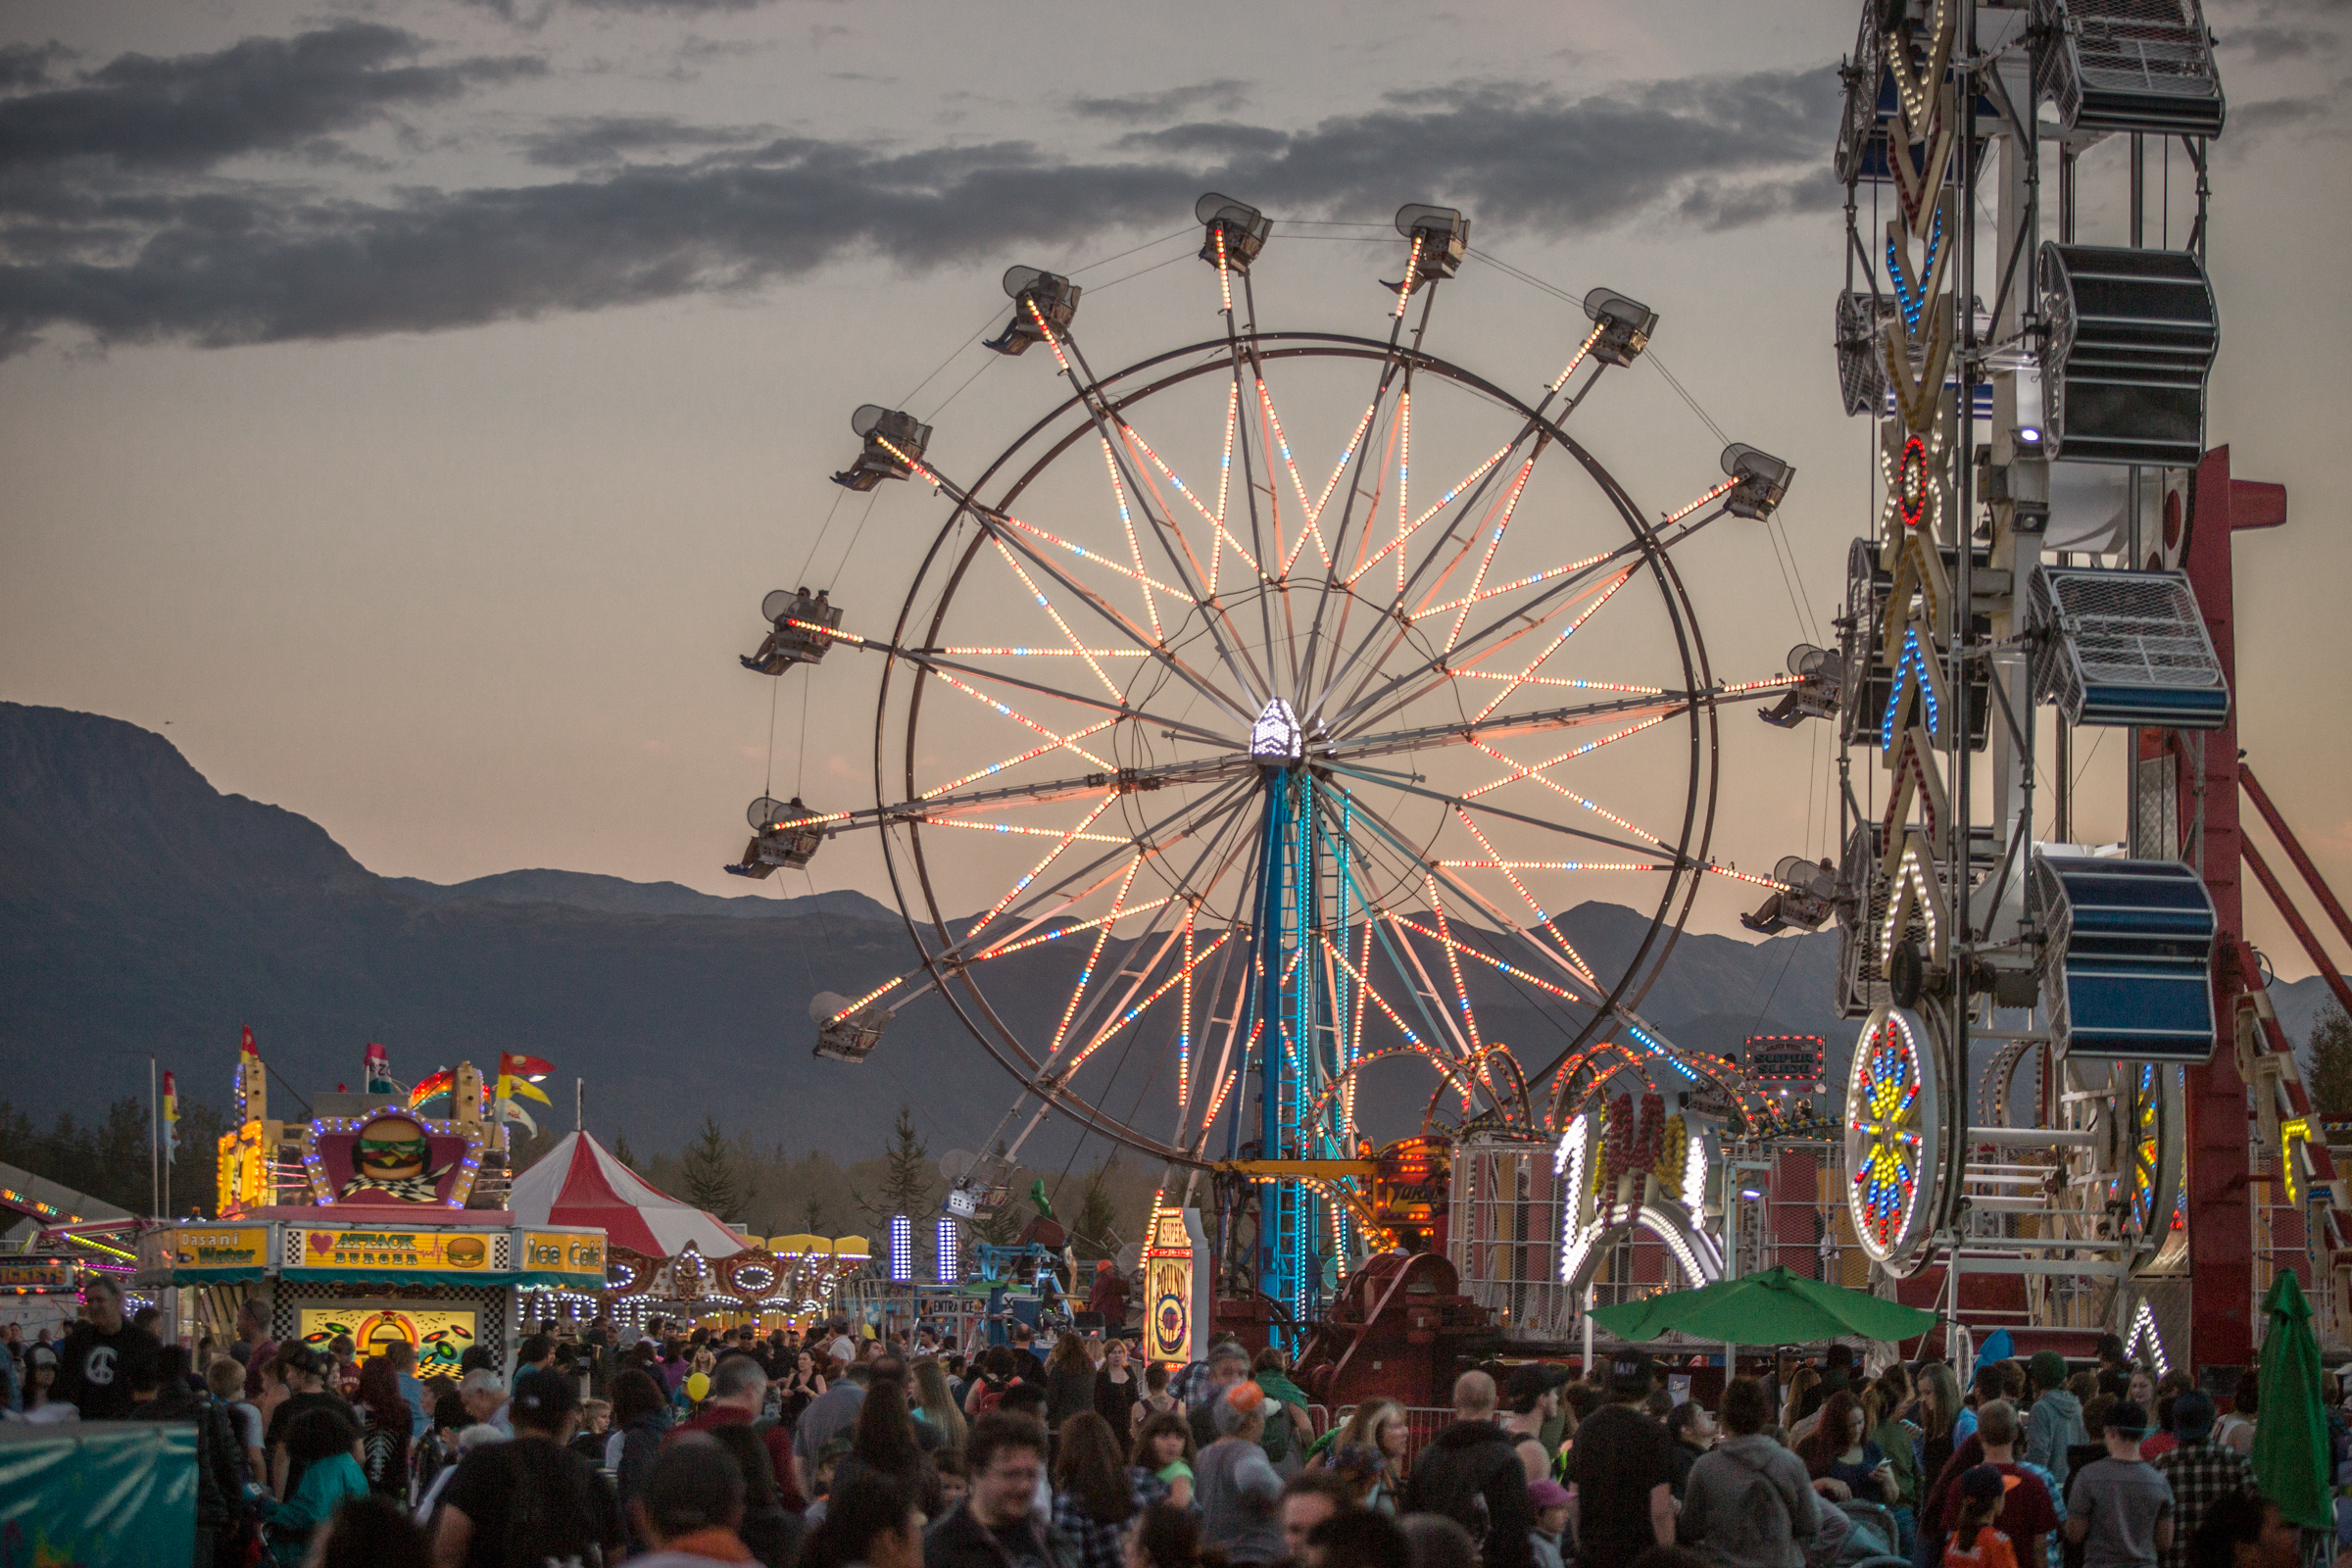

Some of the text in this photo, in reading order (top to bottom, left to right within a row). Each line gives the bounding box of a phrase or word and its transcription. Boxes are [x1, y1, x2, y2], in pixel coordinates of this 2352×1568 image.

[1753, 1054, 1814, 1063] SUPER
[1758, 1064, 1811, 1074] SLIDE
[182, 1232, 239, 1247] Dasani
[1162, 1221, 1183, 1244] SUPER
[336, 1233, 416, 1250] ATTACK
[198, 1247, 256, 1264] Water
[335, 1252, 417, 1265] BURGER
[527, 1238, 601, 1267] Ice Cold
[0, 1266, 67, 1285] ICKETS
